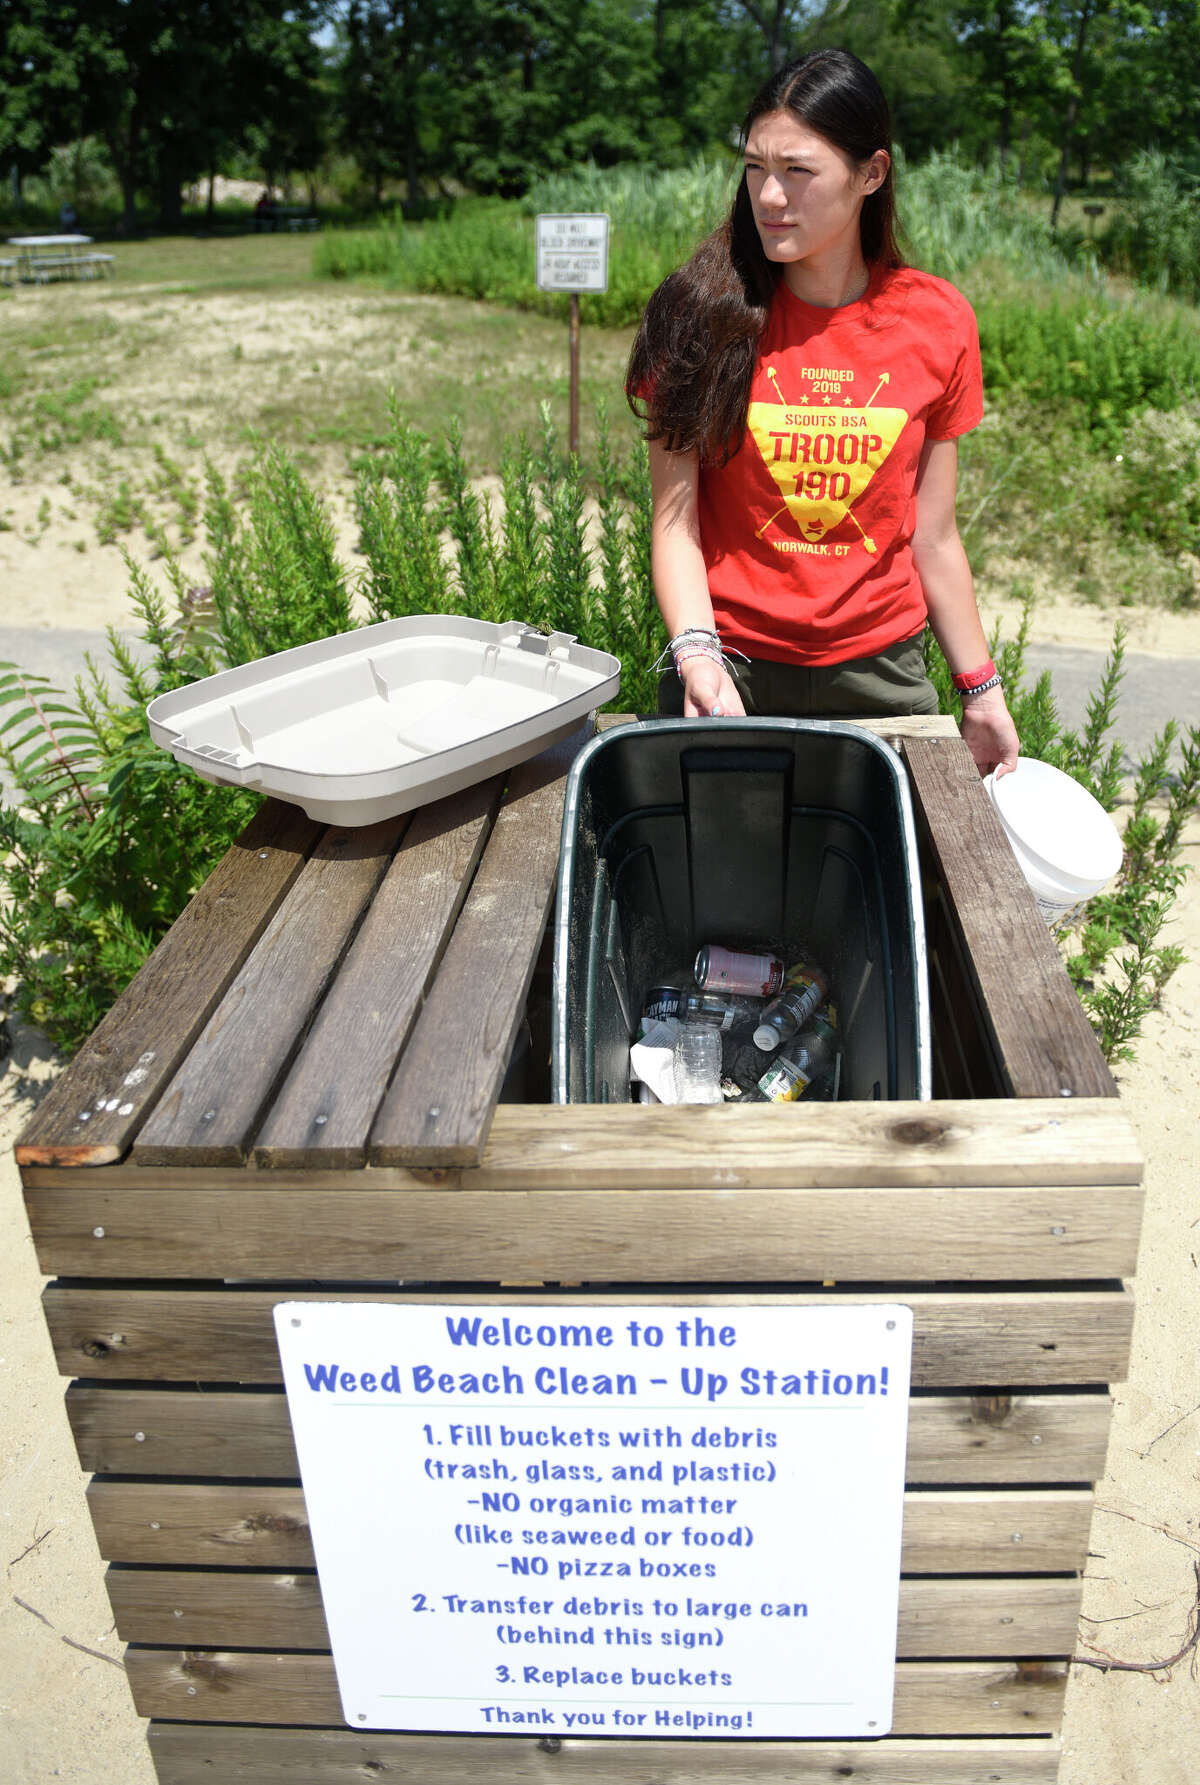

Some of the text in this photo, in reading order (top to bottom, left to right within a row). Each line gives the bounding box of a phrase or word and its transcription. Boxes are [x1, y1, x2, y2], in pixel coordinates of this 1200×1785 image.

[801, 367, 854, 382] FOUNDED
[785, 414, 867, 427] SCOUTS BSA
[769, 431, 883, 465] TROOP
[793, 471, 851, 502] 190
[773, 542, 850, 556] NORWALK, CT
[445, 1316, 737, 1348] Welcome to the
[303, 1363, 402, 1394] Weed
[411, 1364, 524, 1395] Beach
[534, 1366, 637, 1396] Clean
[680, 1367, 729, 1403] Up
[740, 1366, 889, 1397] Station!
[423, 1423, 777, 1449] 1. Fill buckets with debris
[423, 1457, 777, 1486] (trash, glass, and plastic)
[467, 1491, 737, 1517] -NO organic matter
[454, 1523, 754, 1548] (like seaweed or food)
[496, 1556, 716, 1581] -NO pizza boxes
[411, 1593, 808, 1620] 2. Transfer debris to large can
[496, 1624, 724, 1649] (behind this sign)
[495, 1664, 732, 1689] 3. Replace buckets
[479, 1706, 753, 1731] Thank you for Helping!
